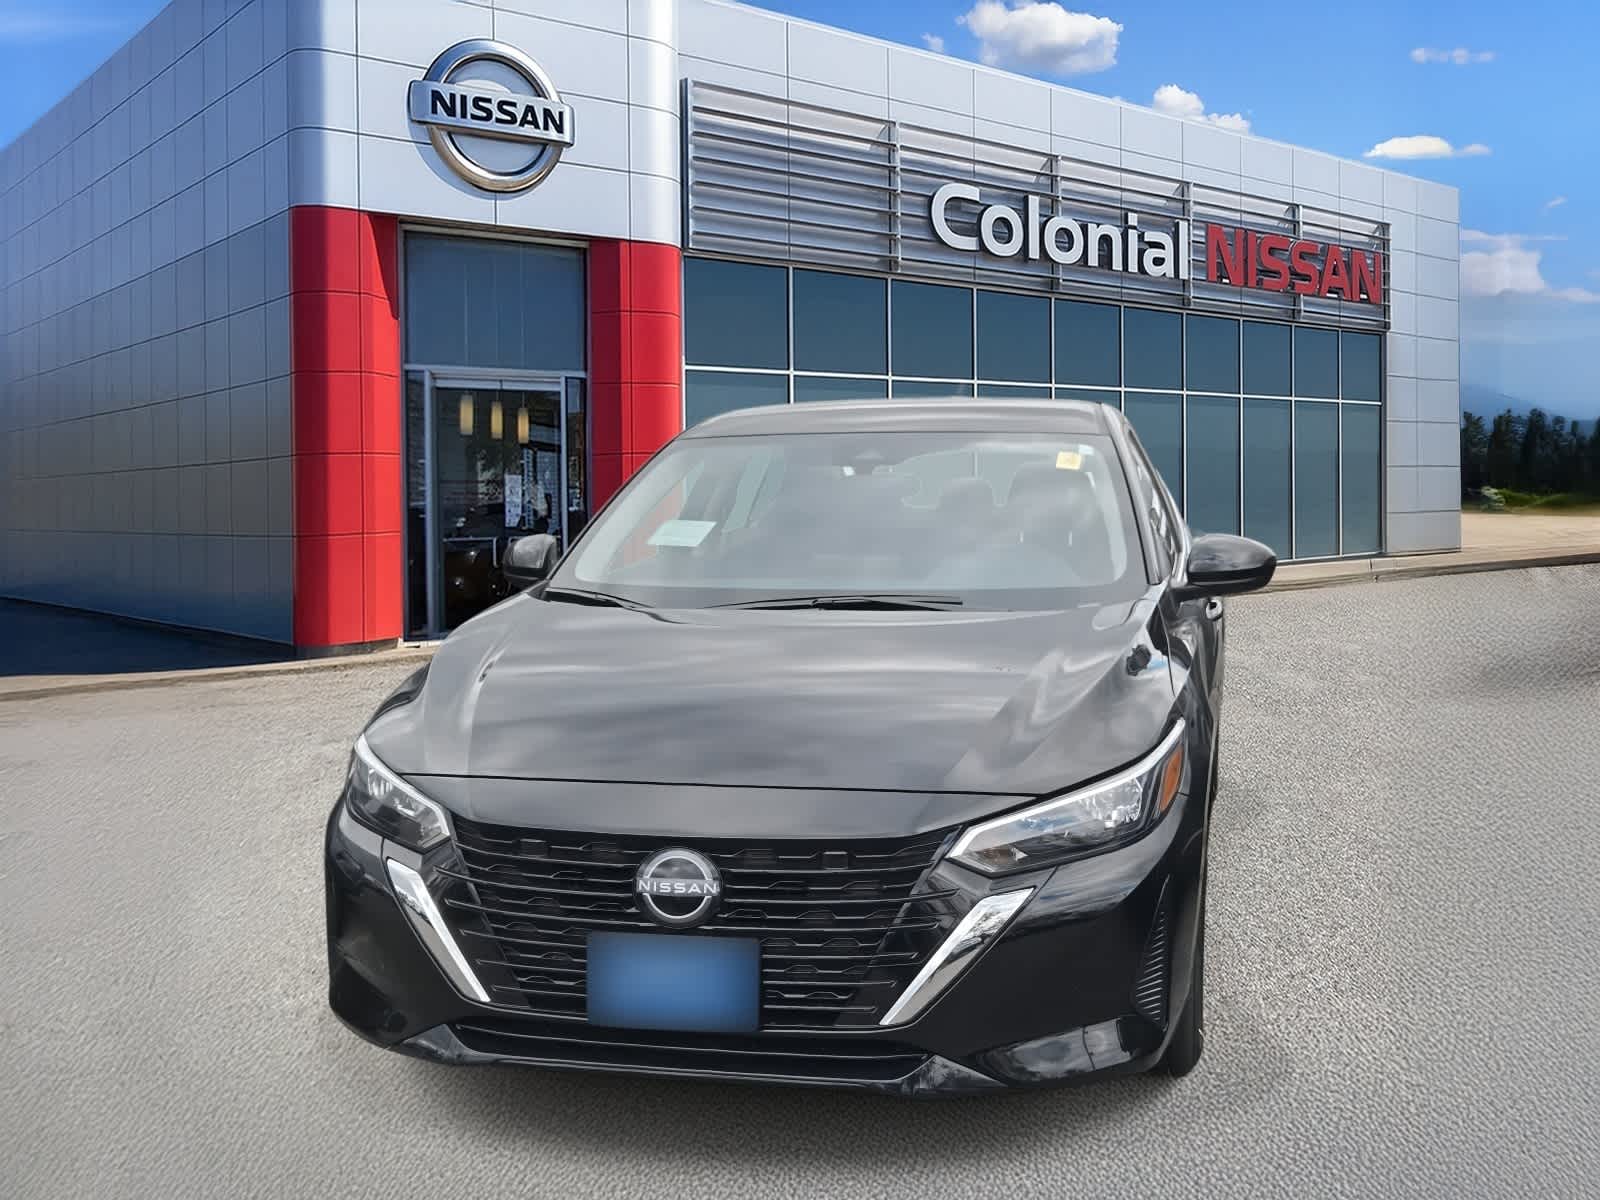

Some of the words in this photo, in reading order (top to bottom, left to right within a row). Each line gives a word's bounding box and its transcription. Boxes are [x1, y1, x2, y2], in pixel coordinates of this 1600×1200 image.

[430, 89, 564, 134] NISSAN
[930, 183, 1188, 280] Colonial
[1206, 223, 1383, 304] NISSAN
[639, 880, 717, 894] NISSAN
